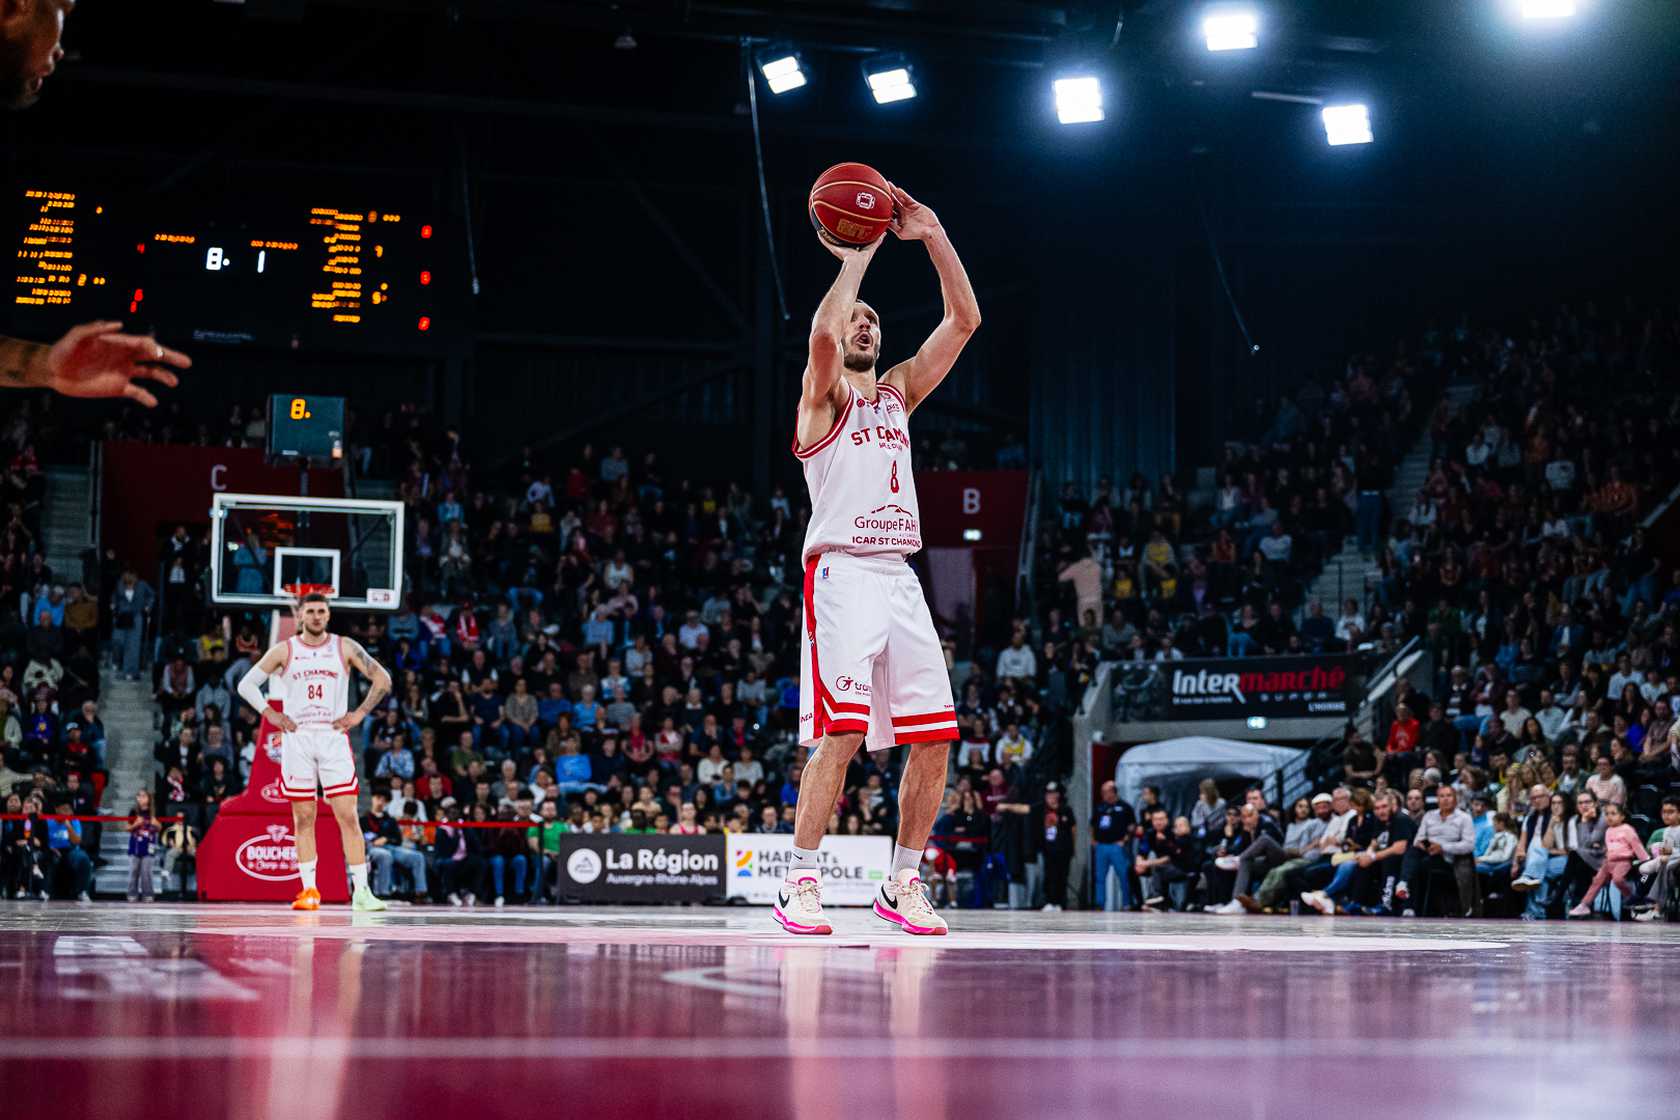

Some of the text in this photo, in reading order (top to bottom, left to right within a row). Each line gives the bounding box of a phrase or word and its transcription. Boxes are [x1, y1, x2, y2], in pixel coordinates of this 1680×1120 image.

[257, 250, 265, 273] 1
[851, 427, 871, 446] ST
[211, 464, 227, 491] C
[890, 460, 900, 493] 8
[963, 488, 981, 514] B
[852, 536, 877, 545] ICAR
[878, 537, 890, 545] ST
[308, 684, 323, 700] 84
[606, 847, 719, 875] La Région
[758, 866, 863, 879] METPOLE
